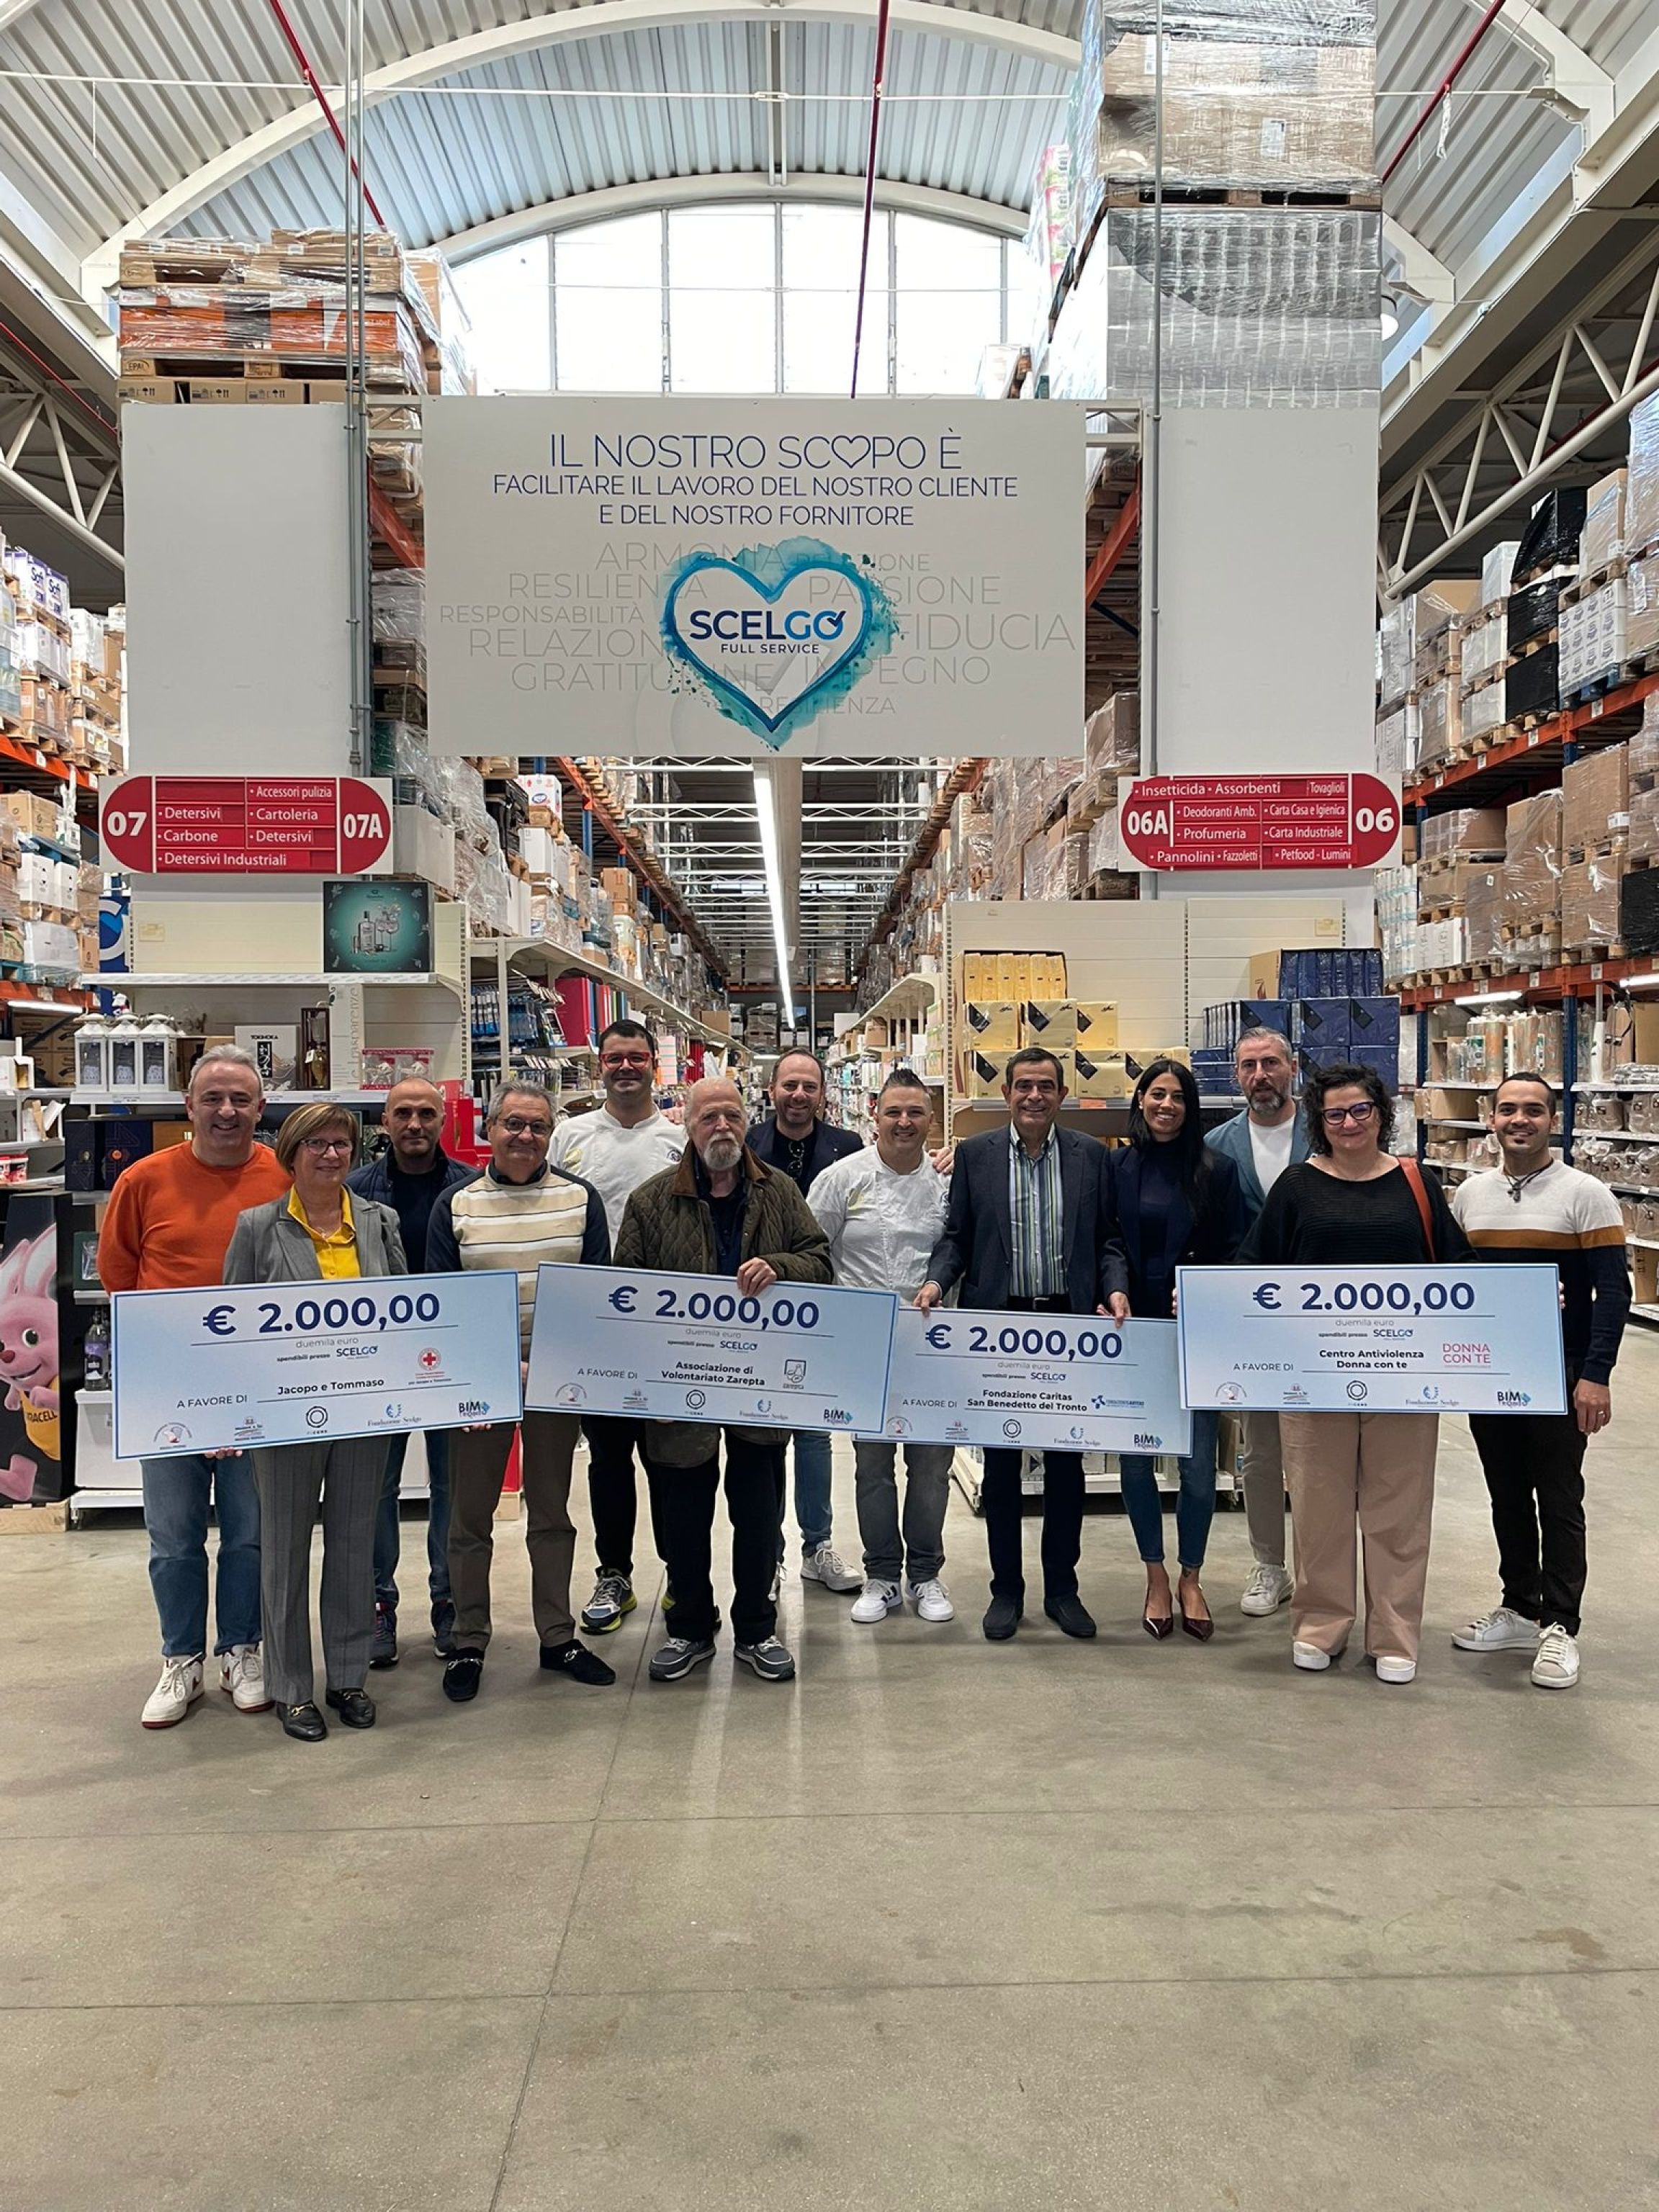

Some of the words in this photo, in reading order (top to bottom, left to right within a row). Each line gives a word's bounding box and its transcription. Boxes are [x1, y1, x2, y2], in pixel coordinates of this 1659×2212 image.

[552, 433, 583, 467] IL
[595, 434, 765, 468] NOSTRO
[940, 427, 962, 469] È
[494, 474, 625, 495] FACILITARE
[632, 475, 651, 495] IL
[657, 475, 755, 495] LAVORO
[762, 477, 806, 496] DEL
[813, 477, 912, 497] NOSTRO
[919, 477, 1018, 497] CLIENTE
[600, 504, 613, 524] E
[621, 505, 667, 525] DEL
[673, 505, 773, 526] NOSTRO
[780, 505, 914, 526] FORNITORE
[809, 575, 1001, 605] PASIONE
[439, 602, 645, 624] RESPONSABILITÀ
[689, 609, 847, 641] SCELGO
[897, 613, 1075, 651] FIDUCIA
[469, 628, 691, 657] RELAZION
[720, 644, 755, 655] FULL
[760, 644, 820, 655] SERVICE
[256, 786, 300, 798] Accessori
[302, 787, 333, 800] pulizia
[1142, 783, 1205, 796] Insetticida
[1215, 781, 1281, 794] Assorbenti
[1310, 781, 1345, 796] Tovaglioli
[165, 806, 221, 819] Detersivi
[256, 808, 318, 820] Cartoleria
[1183, 805, 1232, 817] Deodoranti
[1233, 805, 1256, 817] Amb.
[1269, 804, 1290, 816] Carta
[1291, 804, 1309, 815] Casa
[1316, 804, 1346, 818] Igienica
[108, 811, 147, 837] 07
[343, 813, 383, 839] 07A
[1127, 809, 1169, 835] 06A
[1355, 807, 1395, 832] 06
[163, 830, 218, 842] Carbone
[256, 830, 312, 842] Detersivi
[1183, 828, 1246, 839] Profumeria
[1269, 827, 1293, 838] Carta
[1295, 826, 1343, 838] Industriale
[164, 853, 220, 865] Detersivi
[224, 853, 287, 866] Industriali
[1157, 850, 1215, 863] Pannolini
[1223, 850, 1258, 861] Fazzoletti
[1280, 848, 1315, 860] Petfood
[1321, 849, 1351, 860] Lumini
[1252, 1282, 1282, 1310] €
[1300, 1282, 1475, 1316] 2.000,00
[202, 1305, 237, 1336] €
[258, 1292, 441, 1334] 2.000,00
[608, 1285, 639, 1313] €
[655, 1289, 819, 1330] 2.000,00
[685, 1328, 720, 1338] duemila
[1373, 1328, 1413, 1338] SCELGO
[296, 1338, 336, 1349] duemila
[337, 1336, 359, 1345] euro
[720, 1341, 758, 1351] SCELGO
[925, 1323, 953, 1350] €
[968, 1326, 1123, 1362] 2.000,00
[1442, 1343, 1491, 1353] DONNA
[336, 1345, 378, 1357] SCELGO
[1319, 1349, 1355, 1359] Centro
[1358, 1349, 1424, 1359] Antiviolenza
[1336, 1360, 1372, 1369] Donna
[1396, 1360, 1408, 1369] te
[1443, 1354, 1471, 1363] CON
[1475, 1354, 1491, 1363] TE
[675, 1361, 741, 1374] Associazione
[743, 1365, 753, 1375] di
[1233, 1362, 1241, 1371] A
[587, 1369, 625, 1379] FAVORE
[661, 1370, 724, 1382] Volontariato
[726, 1376, 765, 1386] Zarepta
[1030, 1372, 1066, 1382] SCELGO
[277, 1383, 318, 1395] Jacopo
[331, 1378, 385, 1390] Tommaso
[176, 1400, 185, 1408] A
[187, 1395, 233, 1408] FAVORE
[236, 1395, 248, 1403] DI
[983, 1390, 1038, 1400] Fondazione
[1039, 1392, 1072, 1401] Caritas
[1497, 1390, 1521, 1402] BIM
[459, 1401, 481, 1413] BIM
[911, 1399, 945, 1408] FAVORE
[967, 1398, 985, 1407] San
[987, 1400, 1037, 1410] Benedetto
[1039, 1401, 1054, 1410] del
[1056, 1402, 1087, 1411] Tronto
[824, 1408, 845, 1420] BIM
[1133, 1434, 1154, 1444] BIM
